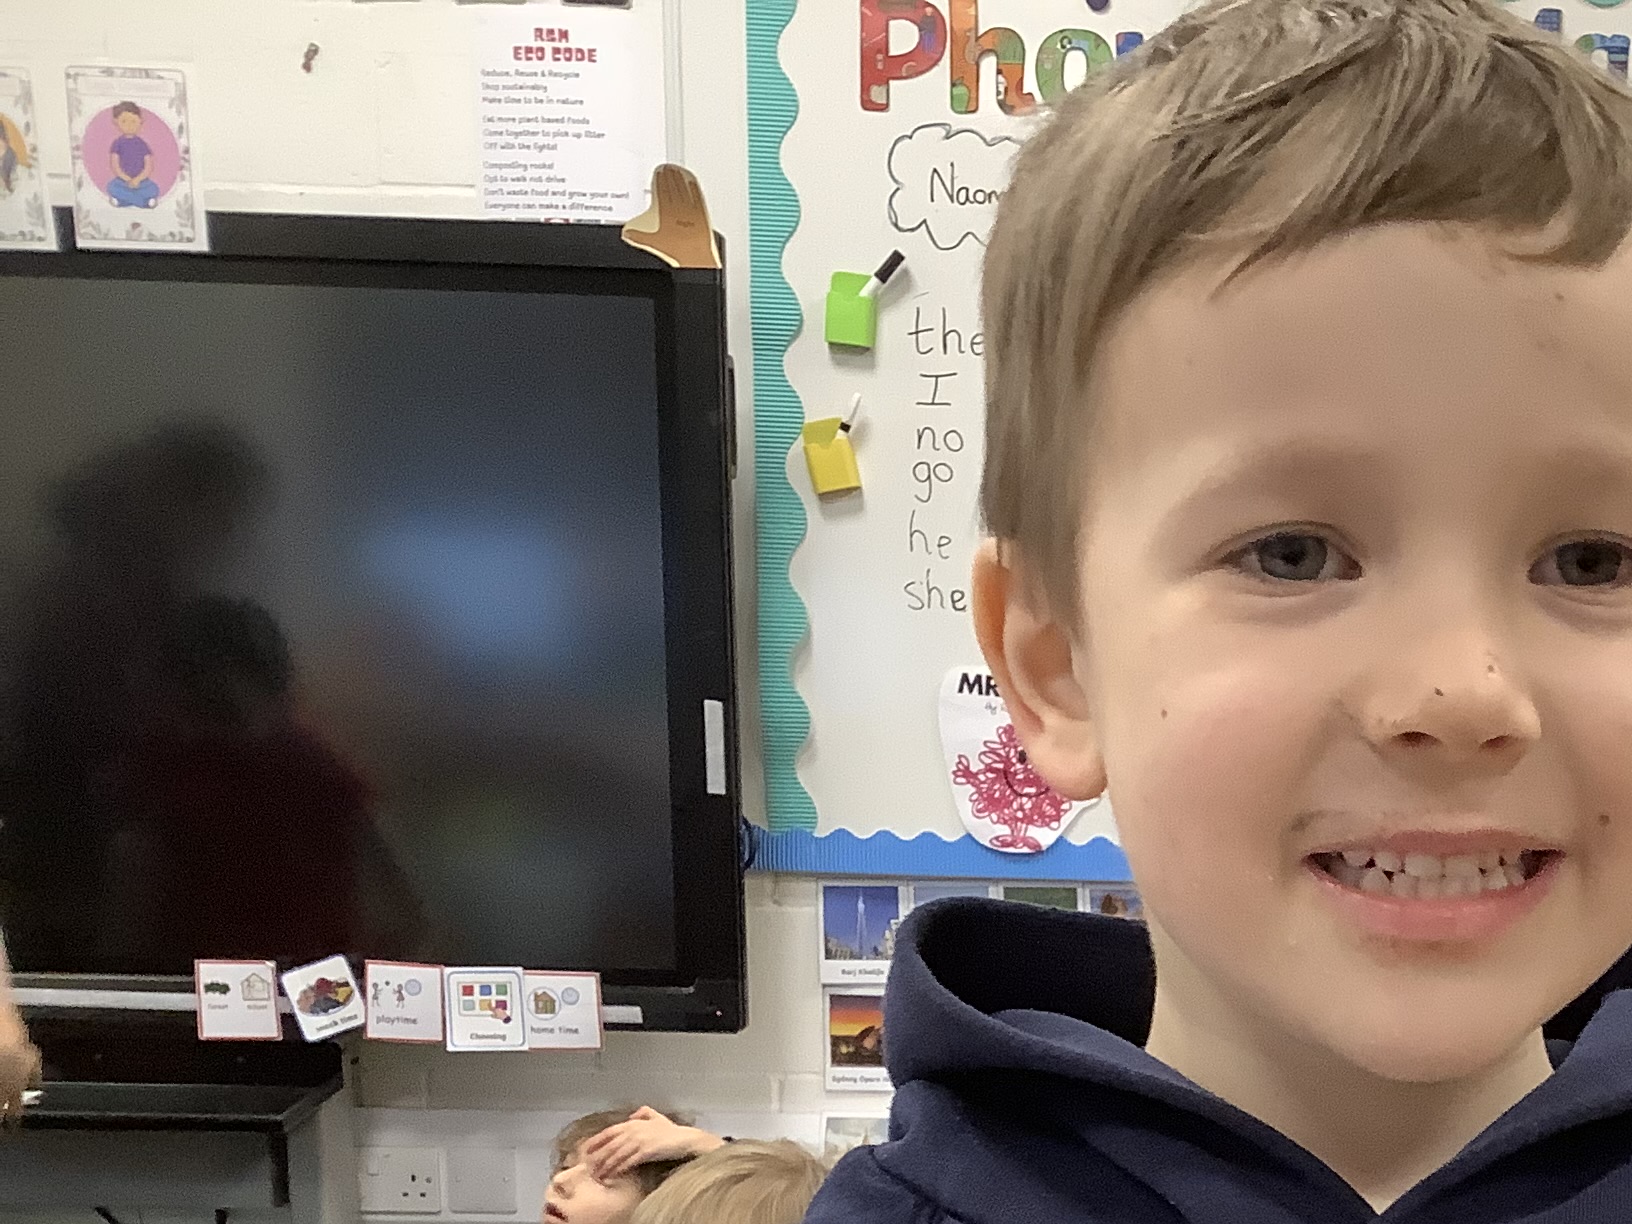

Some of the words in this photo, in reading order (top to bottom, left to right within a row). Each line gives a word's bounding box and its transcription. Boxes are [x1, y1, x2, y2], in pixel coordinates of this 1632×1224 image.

[512, 45, 546, 62] ECO
[551, 47, 598, 63] CODE
[860, 0, 1144, 116] Pho
[523, 96, 532, 104] to
[533, 96, 544, 104] be
[556, 97, 584, 106] nature
[505, 129, 540, 140] together
[541, 129, 551, 137] to
[551, 129, 569, 139] pick
[500, 142, 516, 150] with
[517, 142, 531, 150] the
[500, 175, 509, 183] to
[545, 175, 566, 184] drive
[530, 188, 549, 197] food
[551, 188, 567, 197] and
[568, 190, 587, 200] grow
[484, 201, 520, 212] Everyone
[538, 201, 559, 210] make
[568, 201, 614, 212] difference
[907, 306, 986, 356] the
[916, 372, 958, 407] I
[916, 426, 965, 453] no
[912, 460, 954, 504] go
[908, 510, 952, 560] he
[903, 568, 967, 612] she
[375, 1014, 418, 1026] playtime
[530, 1025, 556, 1035] home
[558, 1026, 579, 1035] time
[469, 1032, 507, 1042] Choosing
